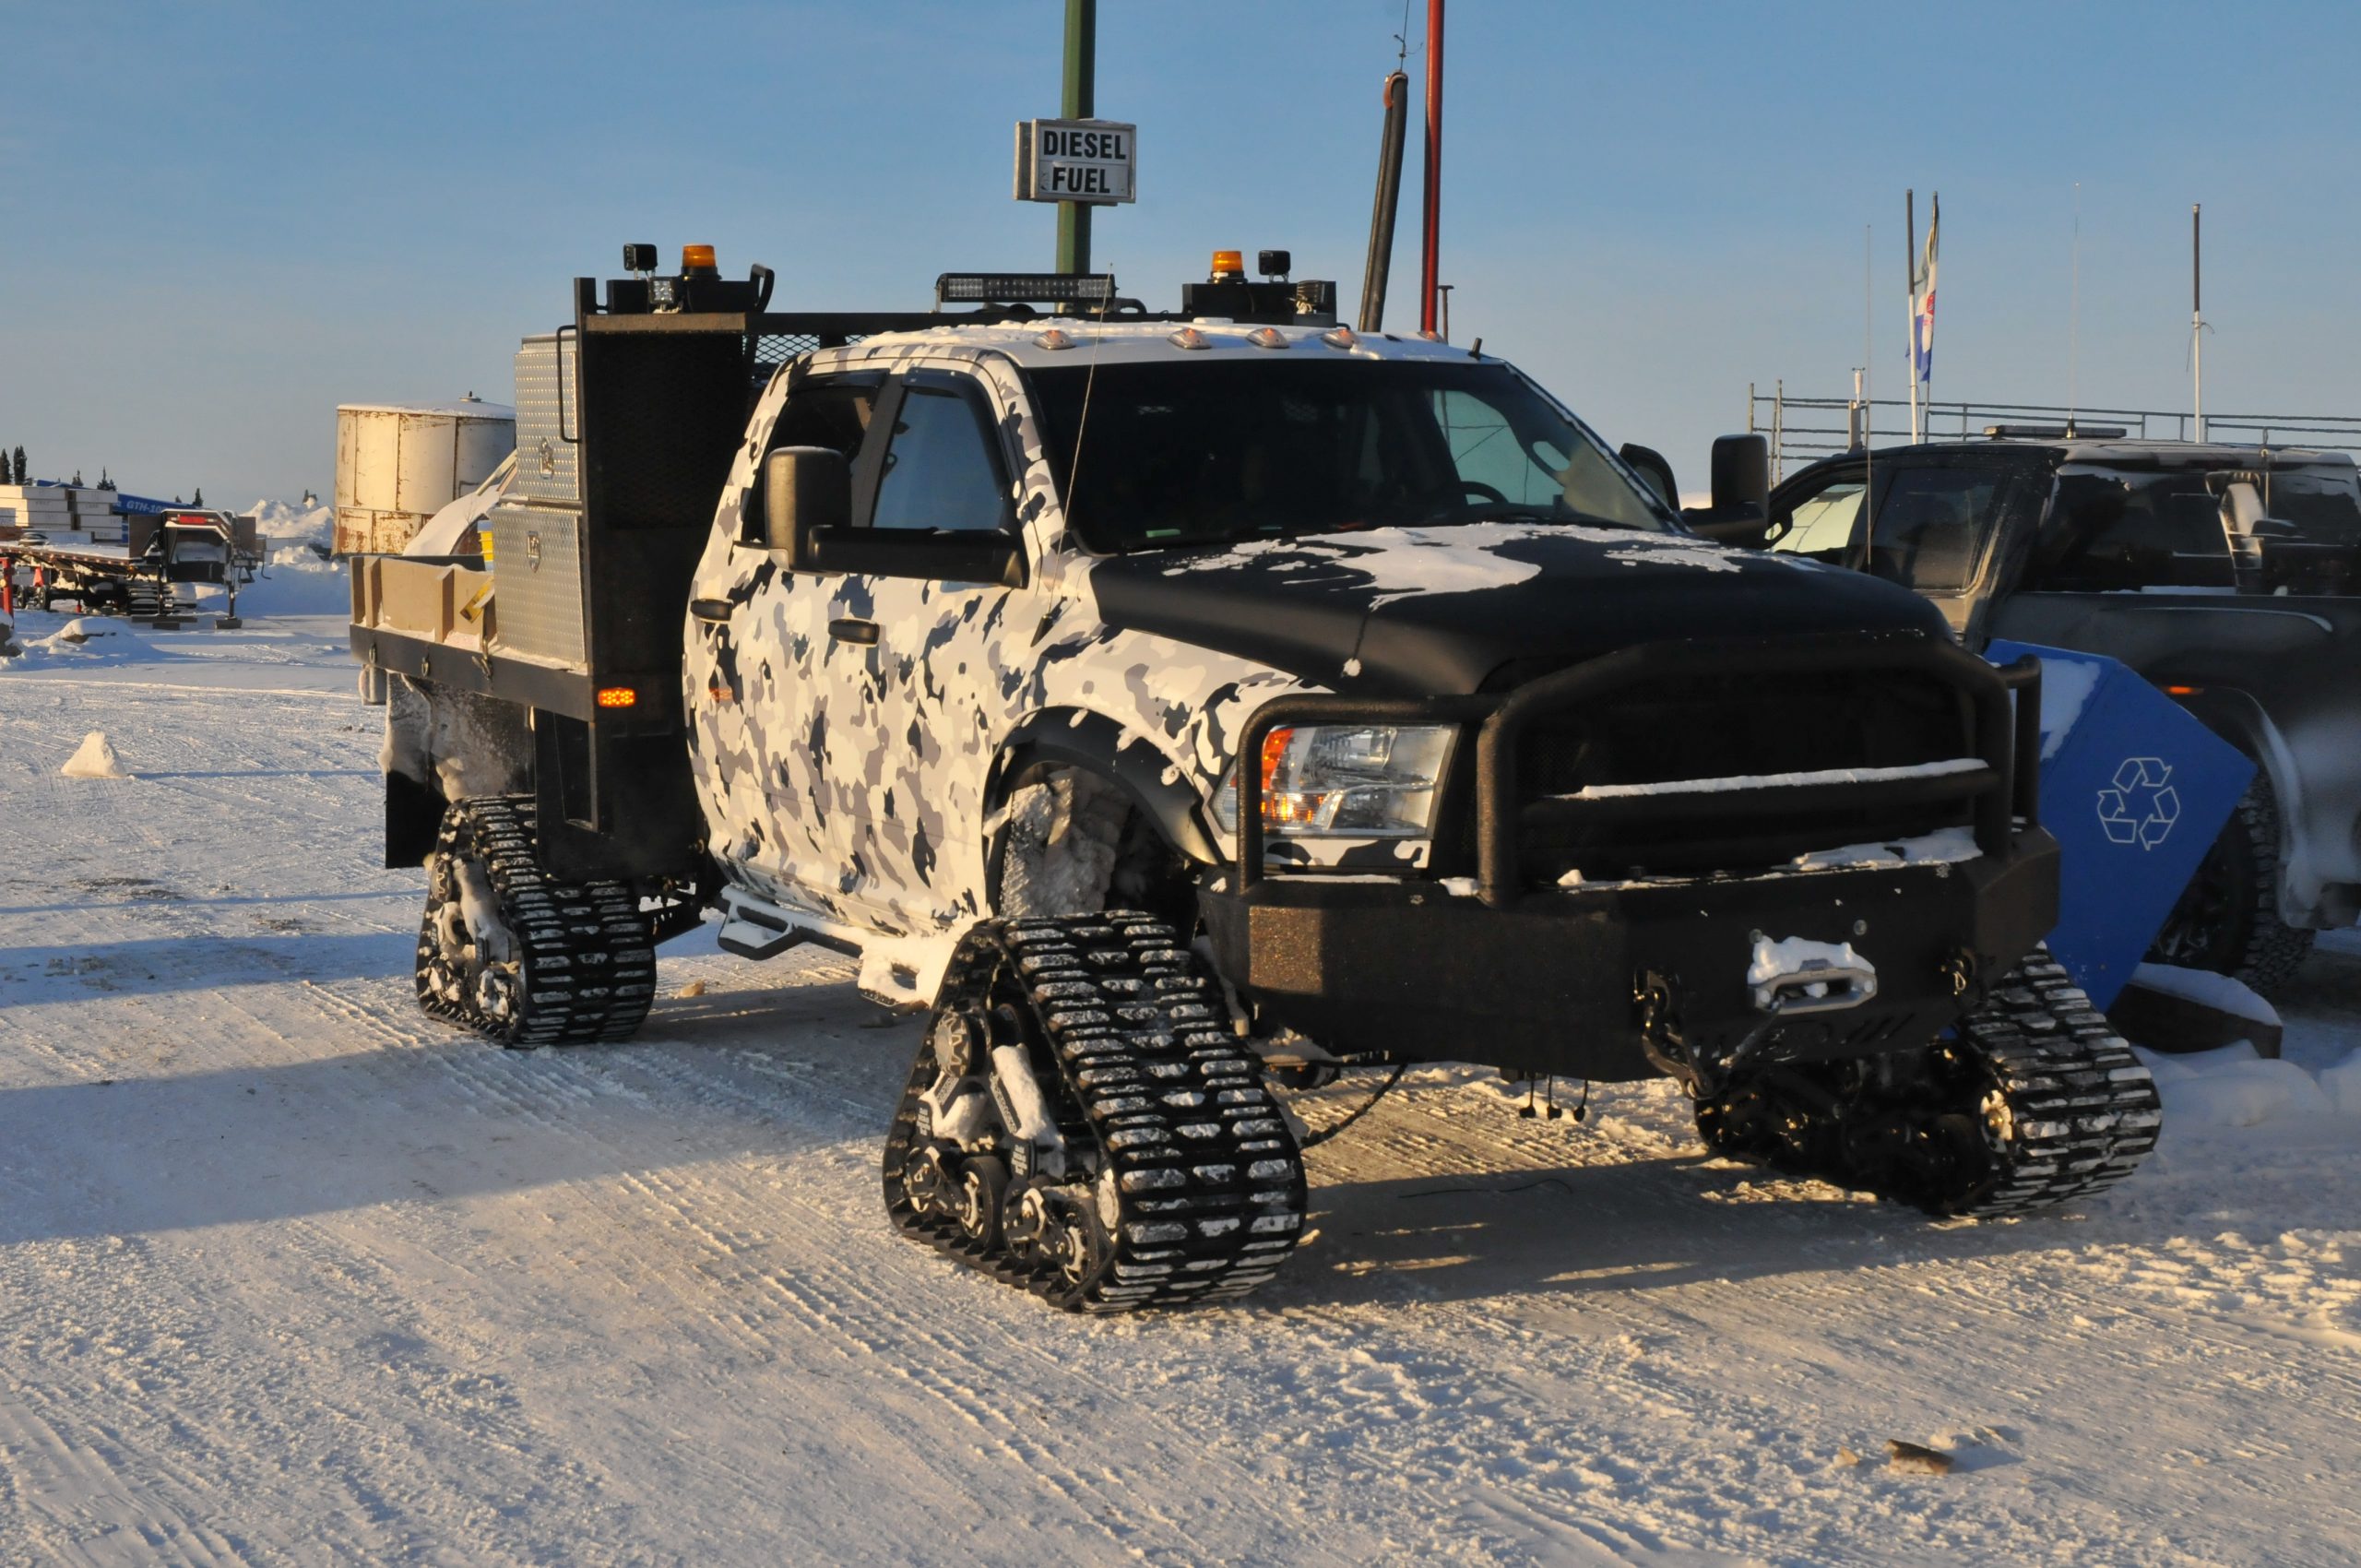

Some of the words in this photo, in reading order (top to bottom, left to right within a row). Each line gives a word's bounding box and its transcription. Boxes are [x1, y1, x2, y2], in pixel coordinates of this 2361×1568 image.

[1043, 131, 1126, 160] DIESEL
[1052, 167, 1110, 194] FUEL
[126, 500, 166, 514] GTH-10
